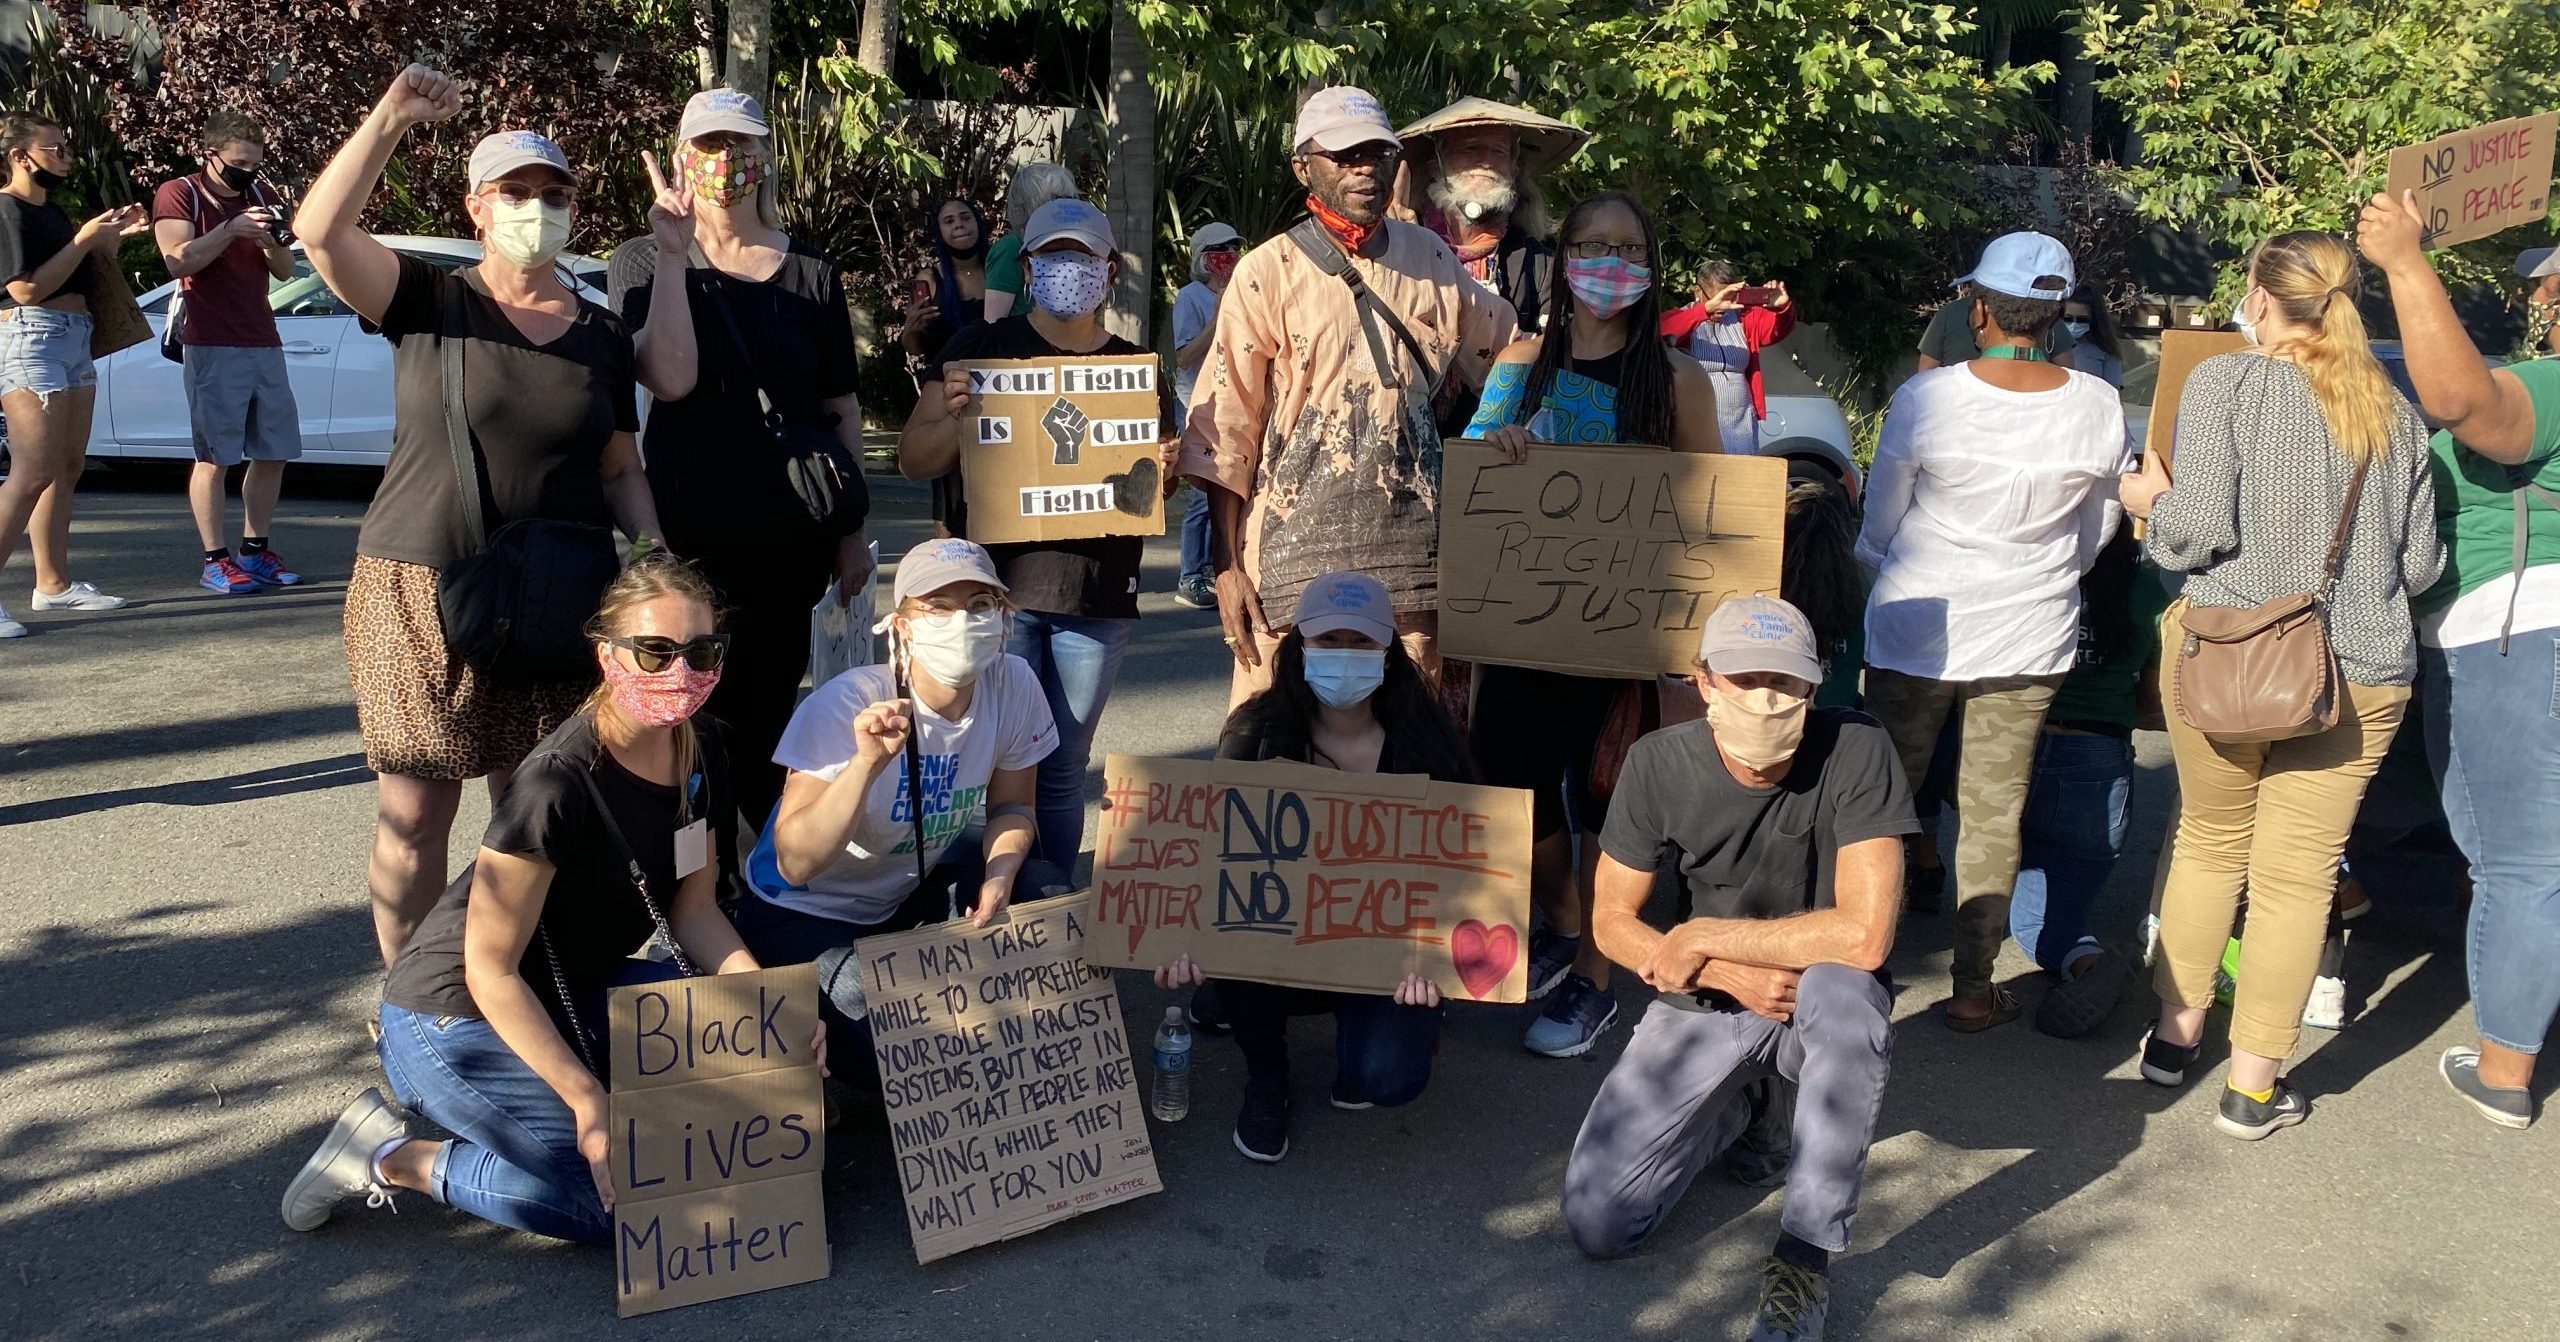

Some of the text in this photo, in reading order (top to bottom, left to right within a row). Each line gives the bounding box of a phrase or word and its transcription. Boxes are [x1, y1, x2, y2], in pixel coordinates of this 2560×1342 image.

[2422, 127, 2532, 183] NO JUSTICE
[2462, 176, 2528, 223] PEACE
[969, 366, 1152, 393] Your Fight
[980, 418, 1156, 444] Is Our
[1021, 487, 1111, 514] Fight
[1464, 463, 1761, 548] EQUAL
[1496, 521, 1718, 580] RIGHTS
[1513, 580, 1779, 634] JUSTI
[1107, 776, 1227, 833] #BLACK
[1222, 787, 1491, 860] NO JUSTICE
[1105, 835, 1200, 871] LIVES
[1099, 879, 1203, 929] MATTER
[1217, 868, 1440, 938] NO PEACE
[872, 912, 1084, 992] IT MAY TAKE A
[635, 986, 788, 1076] Black
[869, 992, 931, 1036] WHILE
[937, 984, 968, 1015] TO
[876, 994, 1115, 1076] YOUR ROLE IN RACIST
[885, 1027, 1123, 1109] SYSTEMS, BUT KEEP IN
[893, 1057, 1135, 1153] MIND THAT PEOPLE ARE
[628, 1113, 811, 1189] Lives
[900, 1101, 1124, 1194] DYING WHILE THEY
[911, 1143, 1103, 1230] WAIT FOR YOU
[621, 1215, 804, 1295] Matter
